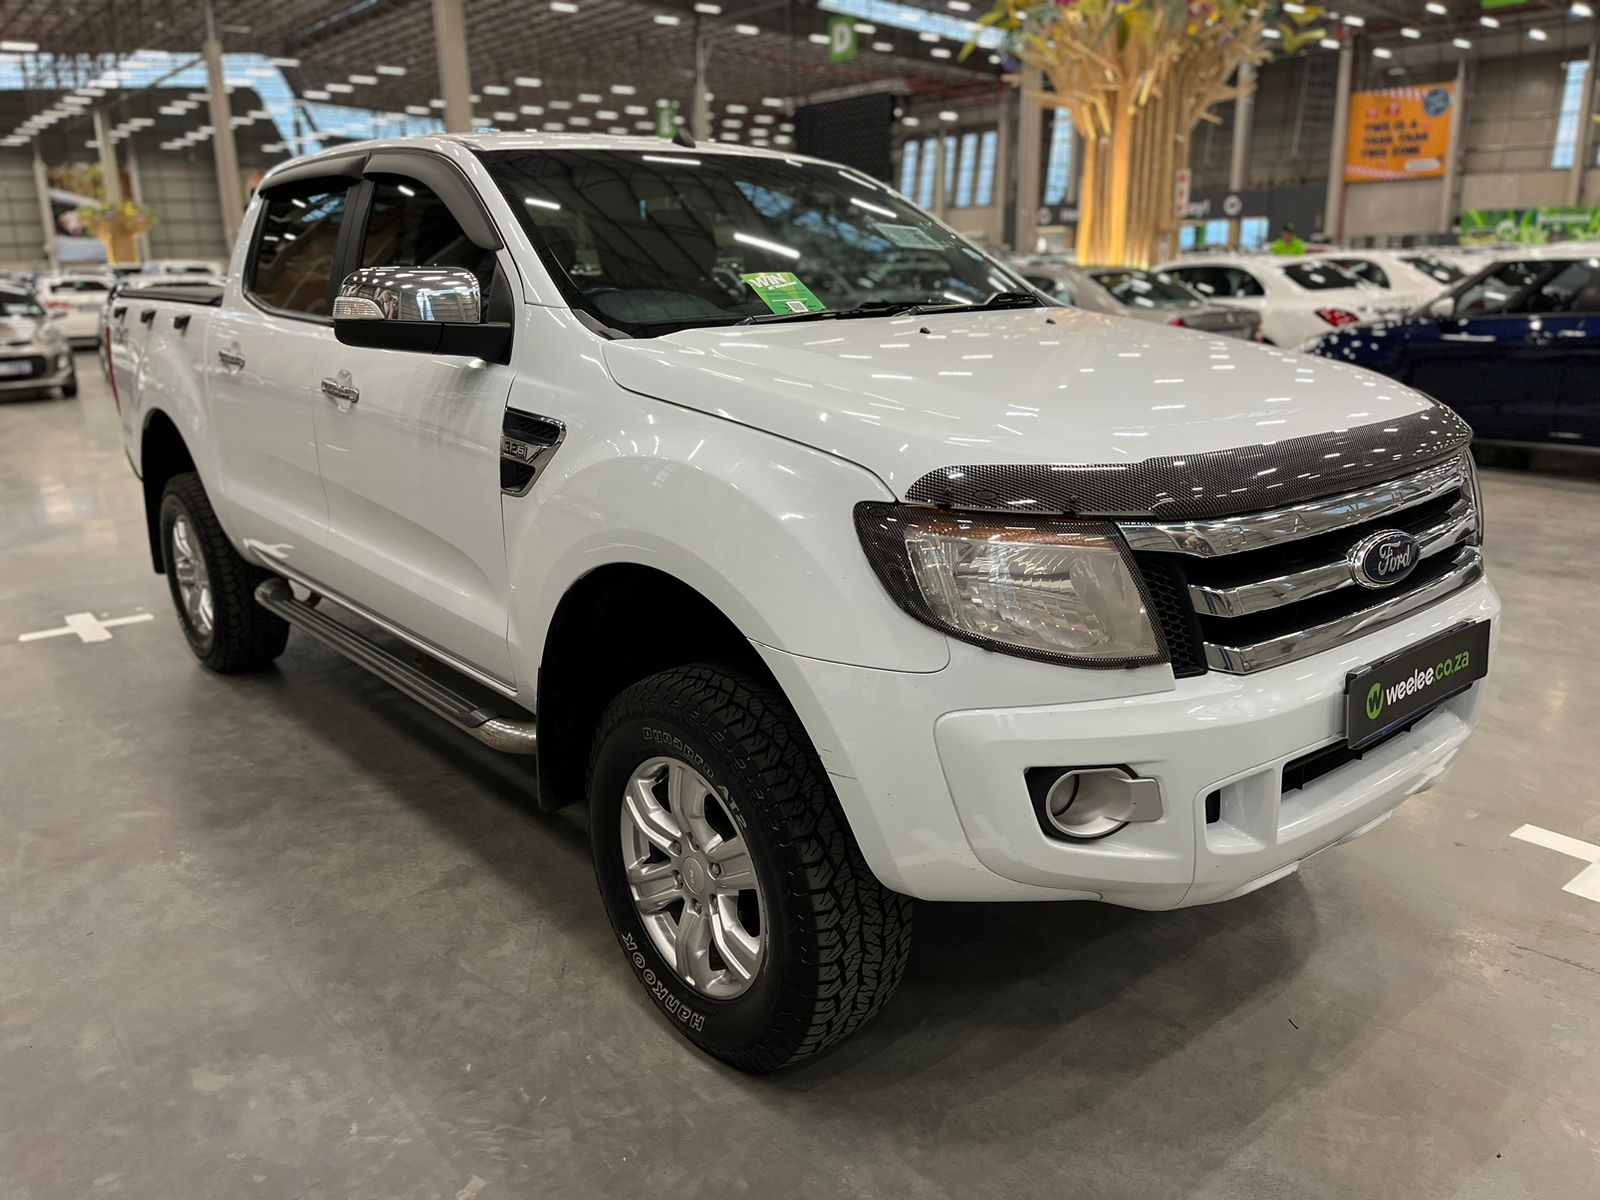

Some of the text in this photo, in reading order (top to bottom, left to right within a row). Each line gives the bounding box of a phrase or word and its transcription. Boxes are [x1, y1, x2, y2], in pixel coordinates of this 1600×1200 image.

[833, 23, 851, 54] D
[749, 272, 788, 288] WIN
[1378, 540, 1412, 576] Ford
[1386, 650, 1470, 706] weelee.co.za
